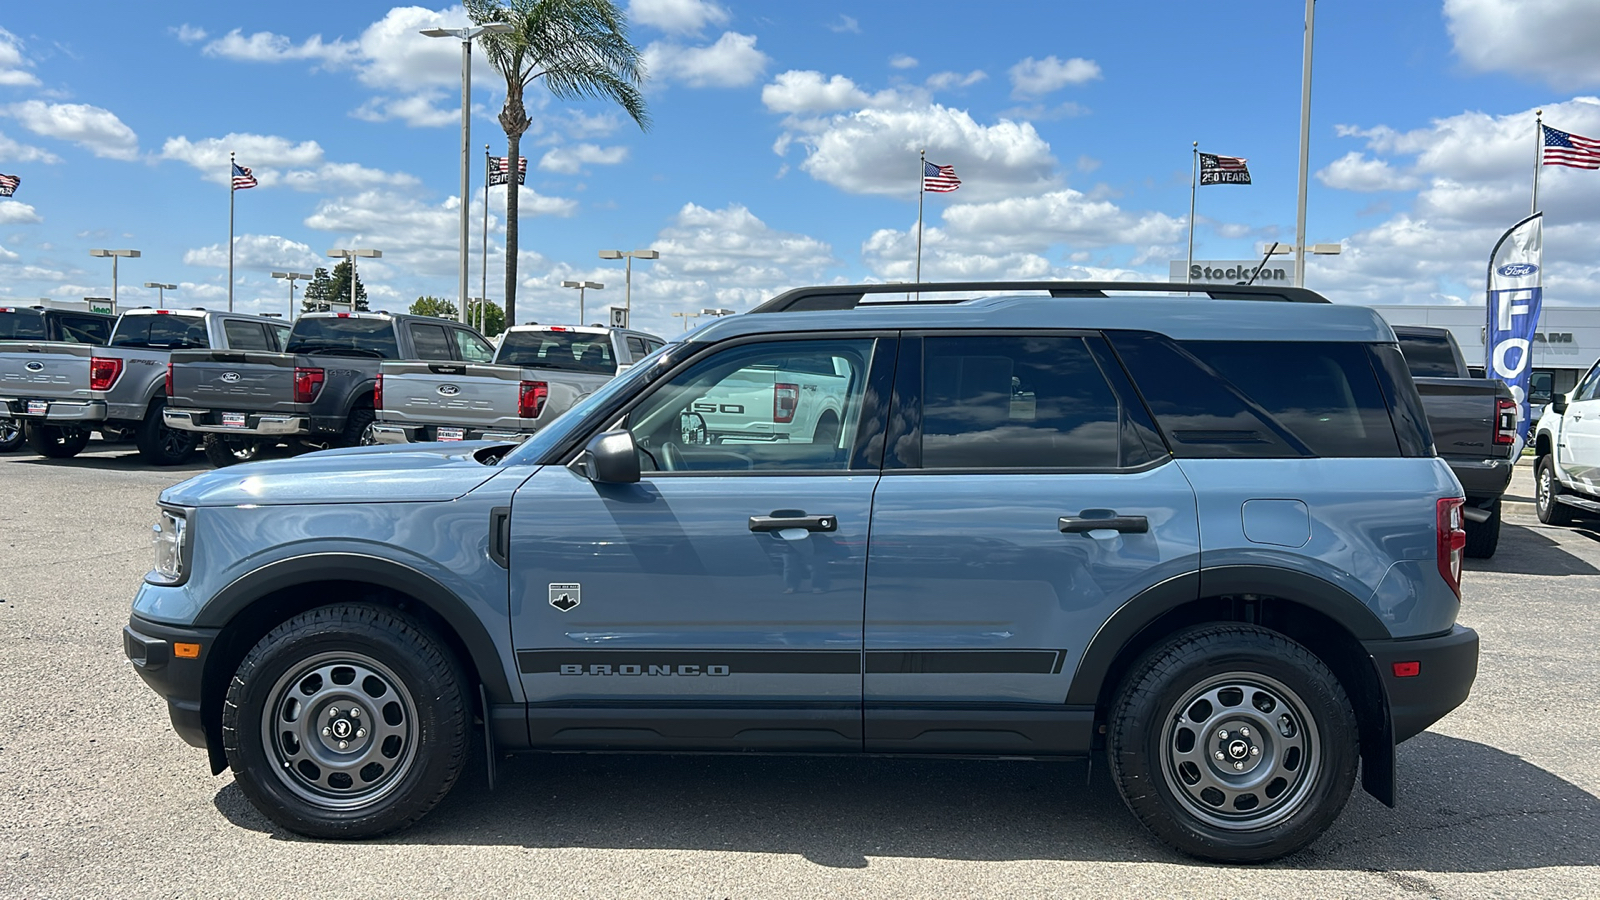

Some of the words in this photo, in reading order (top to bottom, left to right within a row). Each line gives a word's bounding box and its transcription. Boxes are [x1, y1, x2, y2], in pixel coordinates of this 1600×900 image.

[501, 173, 524, 182] YES
[1202, 172, 1220, 182] 250
[1221, 172, 1250, 182] YEARS
[1190, 265, 1285, 280] Stockton
[1503, 264, 1532, 277] Ford
[90, 305, 111, 314] Jeep
[1534, 332, 1573, 343] AM
[223, 372, 239, 381] Ford
[439, 385, 458, 394] Ford
[560, 664, 731, 676] BRONCO
